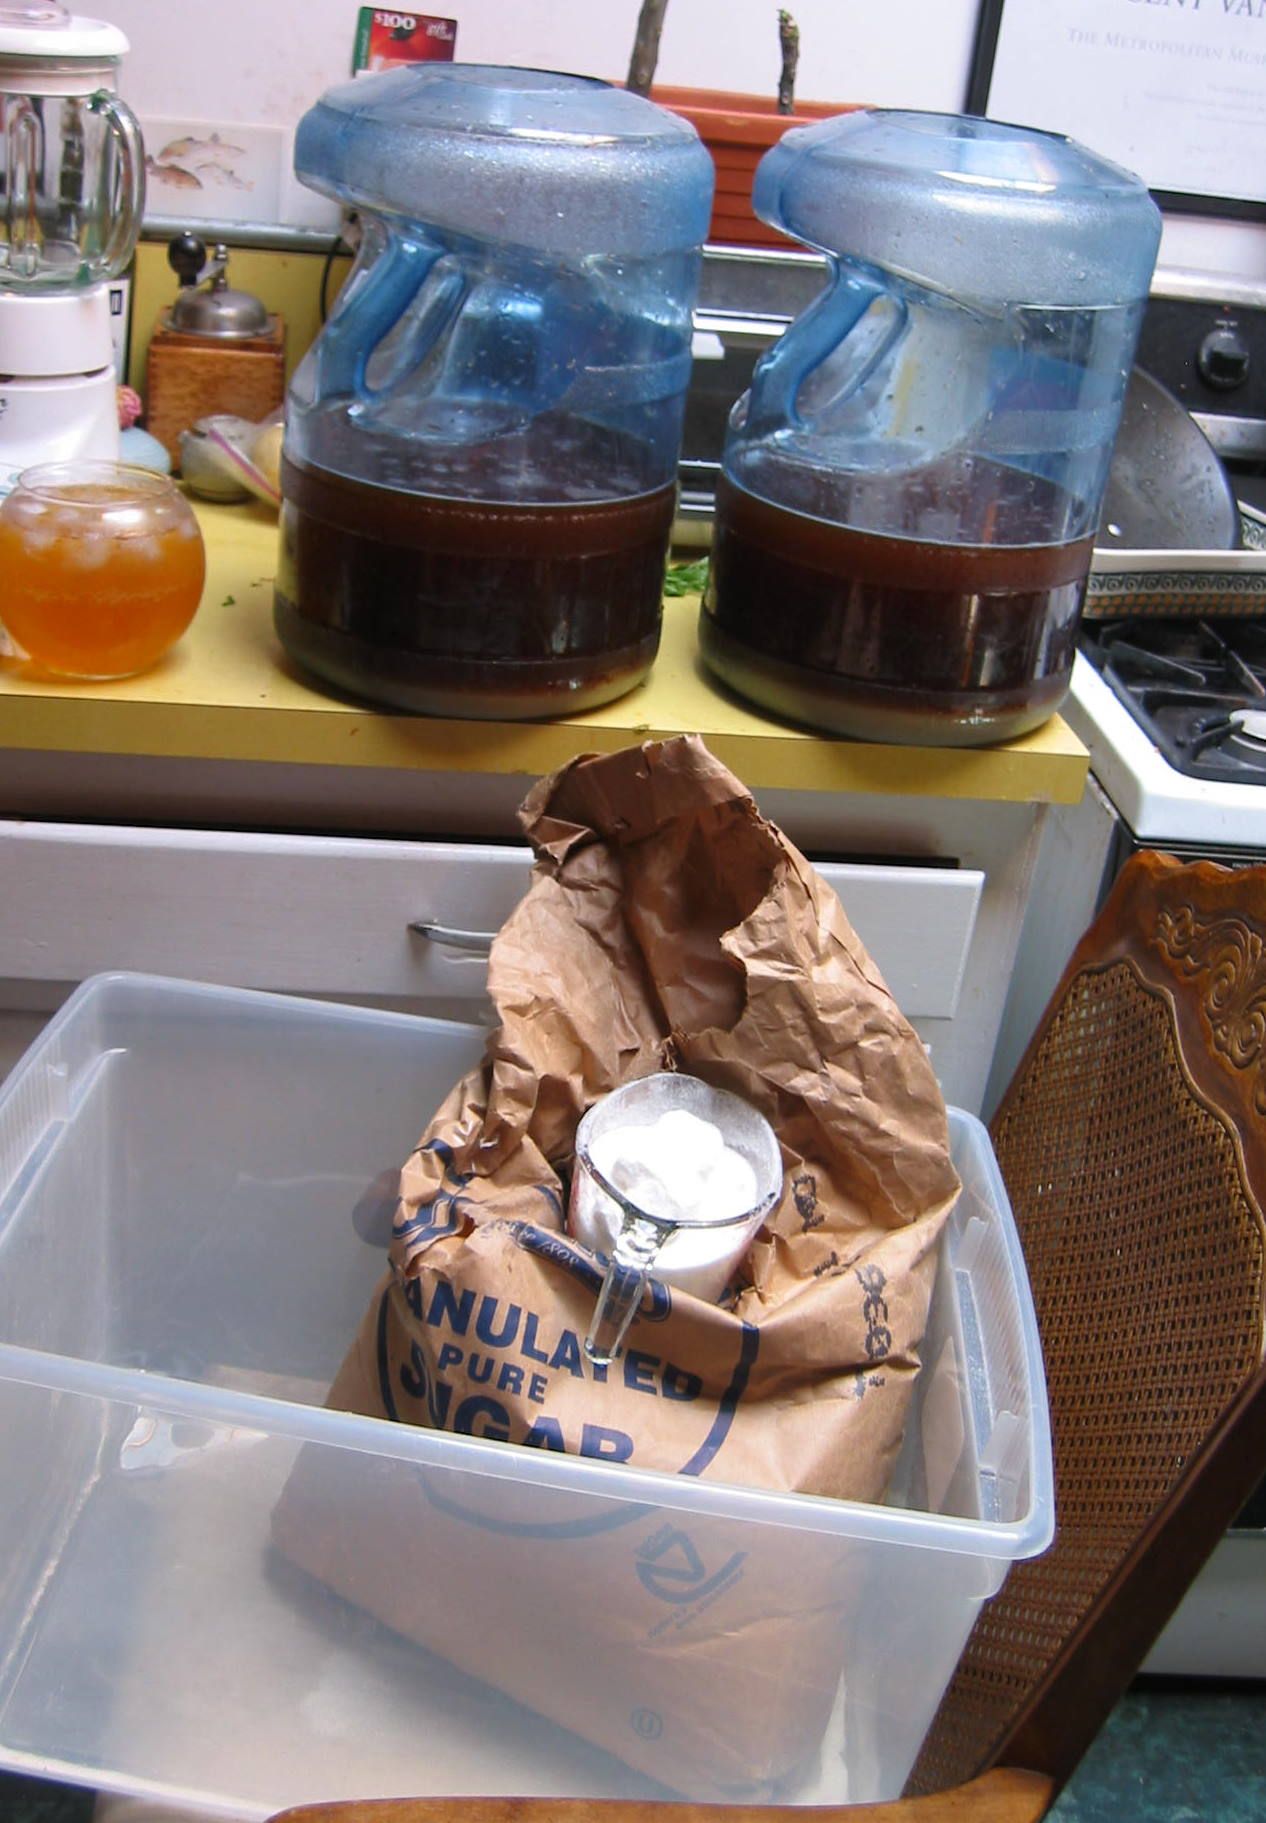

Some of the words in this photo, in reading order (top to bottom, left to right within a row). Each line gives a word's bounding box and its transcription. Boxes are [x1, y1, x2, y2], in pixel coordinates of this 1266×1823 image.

[374, 12, 416, 30] $100
[1068, 27, 1098, 45] THE
[1104, 31, 1223, 61] METROPOLITAN
[437, 1343, 549, 1405] PURE
